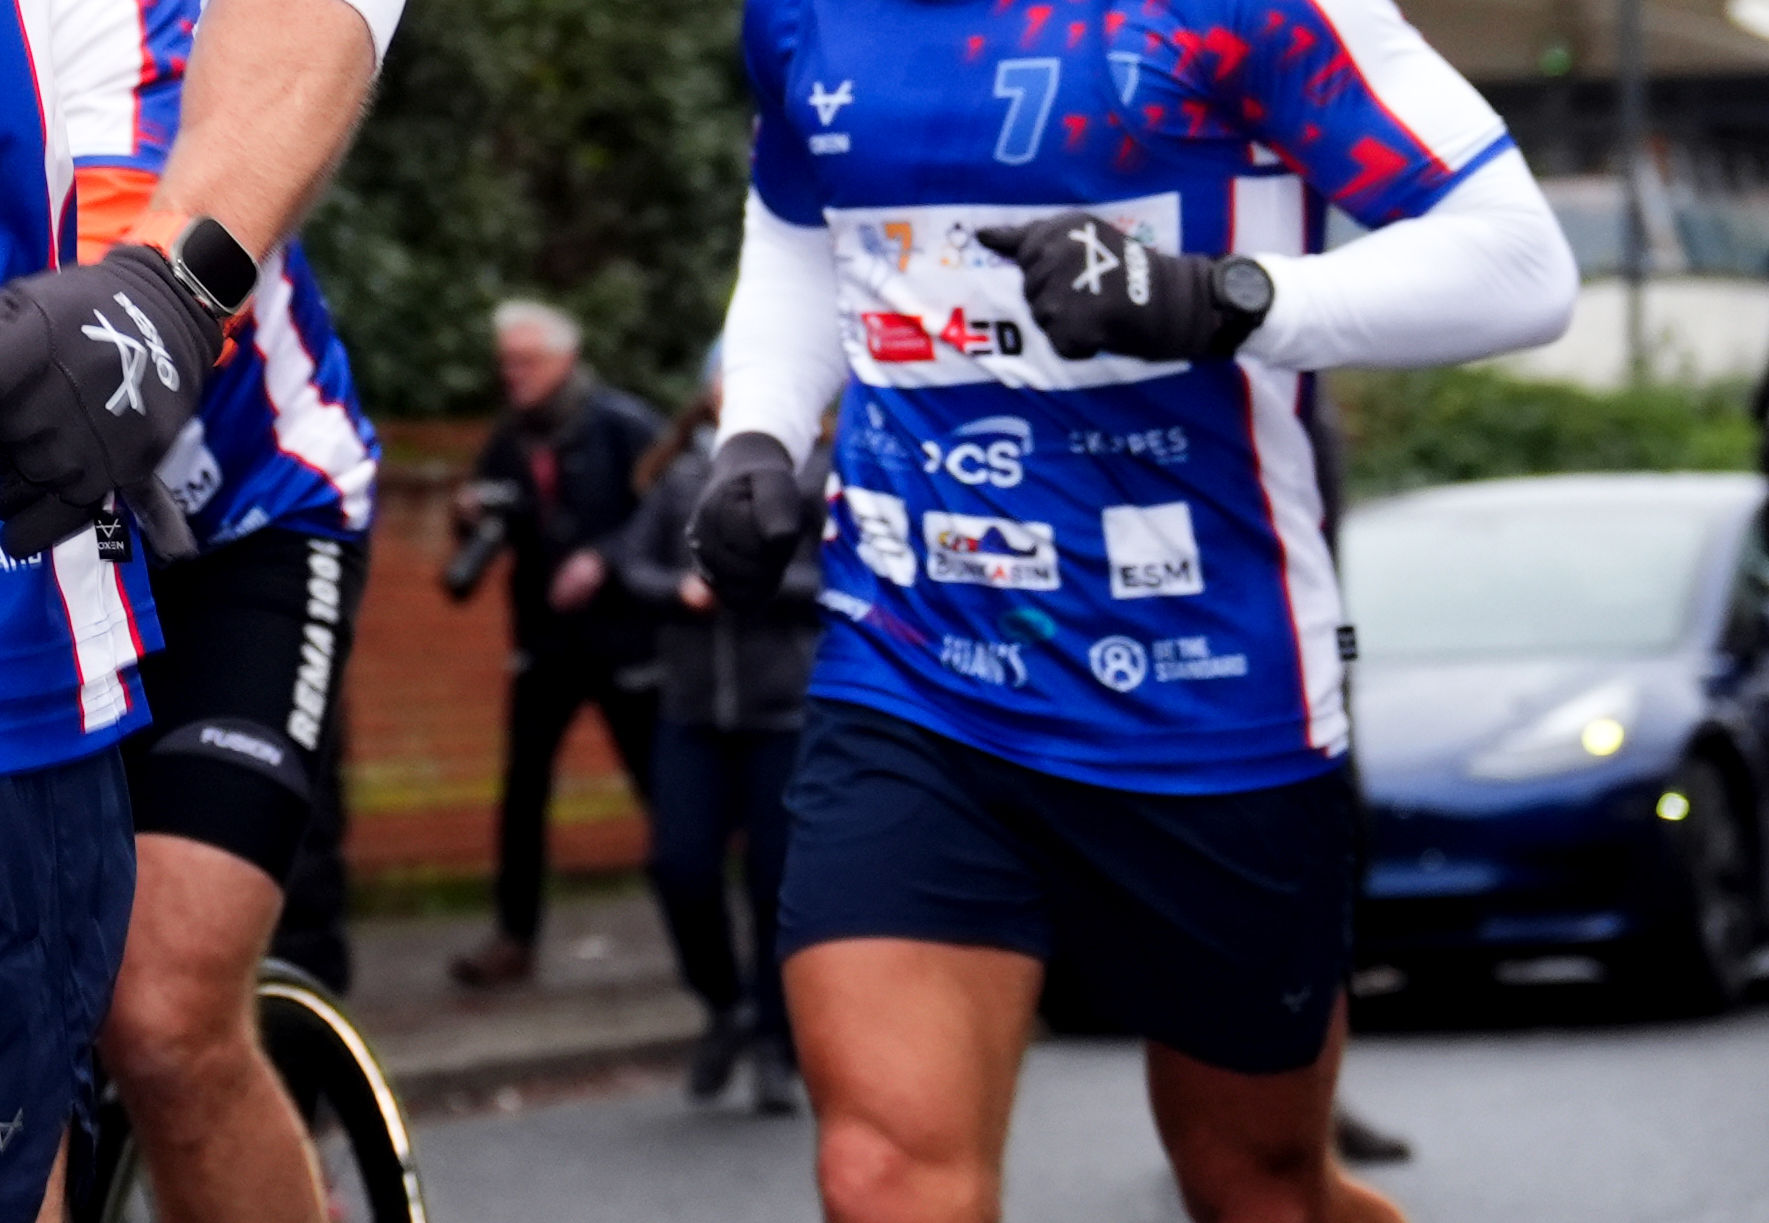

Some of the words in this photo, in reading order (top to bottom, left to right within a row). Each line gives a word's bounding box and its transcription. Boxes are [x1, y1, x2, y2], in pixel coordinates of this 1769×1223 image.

[994, 57, 1060, 165] 7
[97, 541, 124, 551] OXEN
[1120, 559, 1194, 589] ESM
